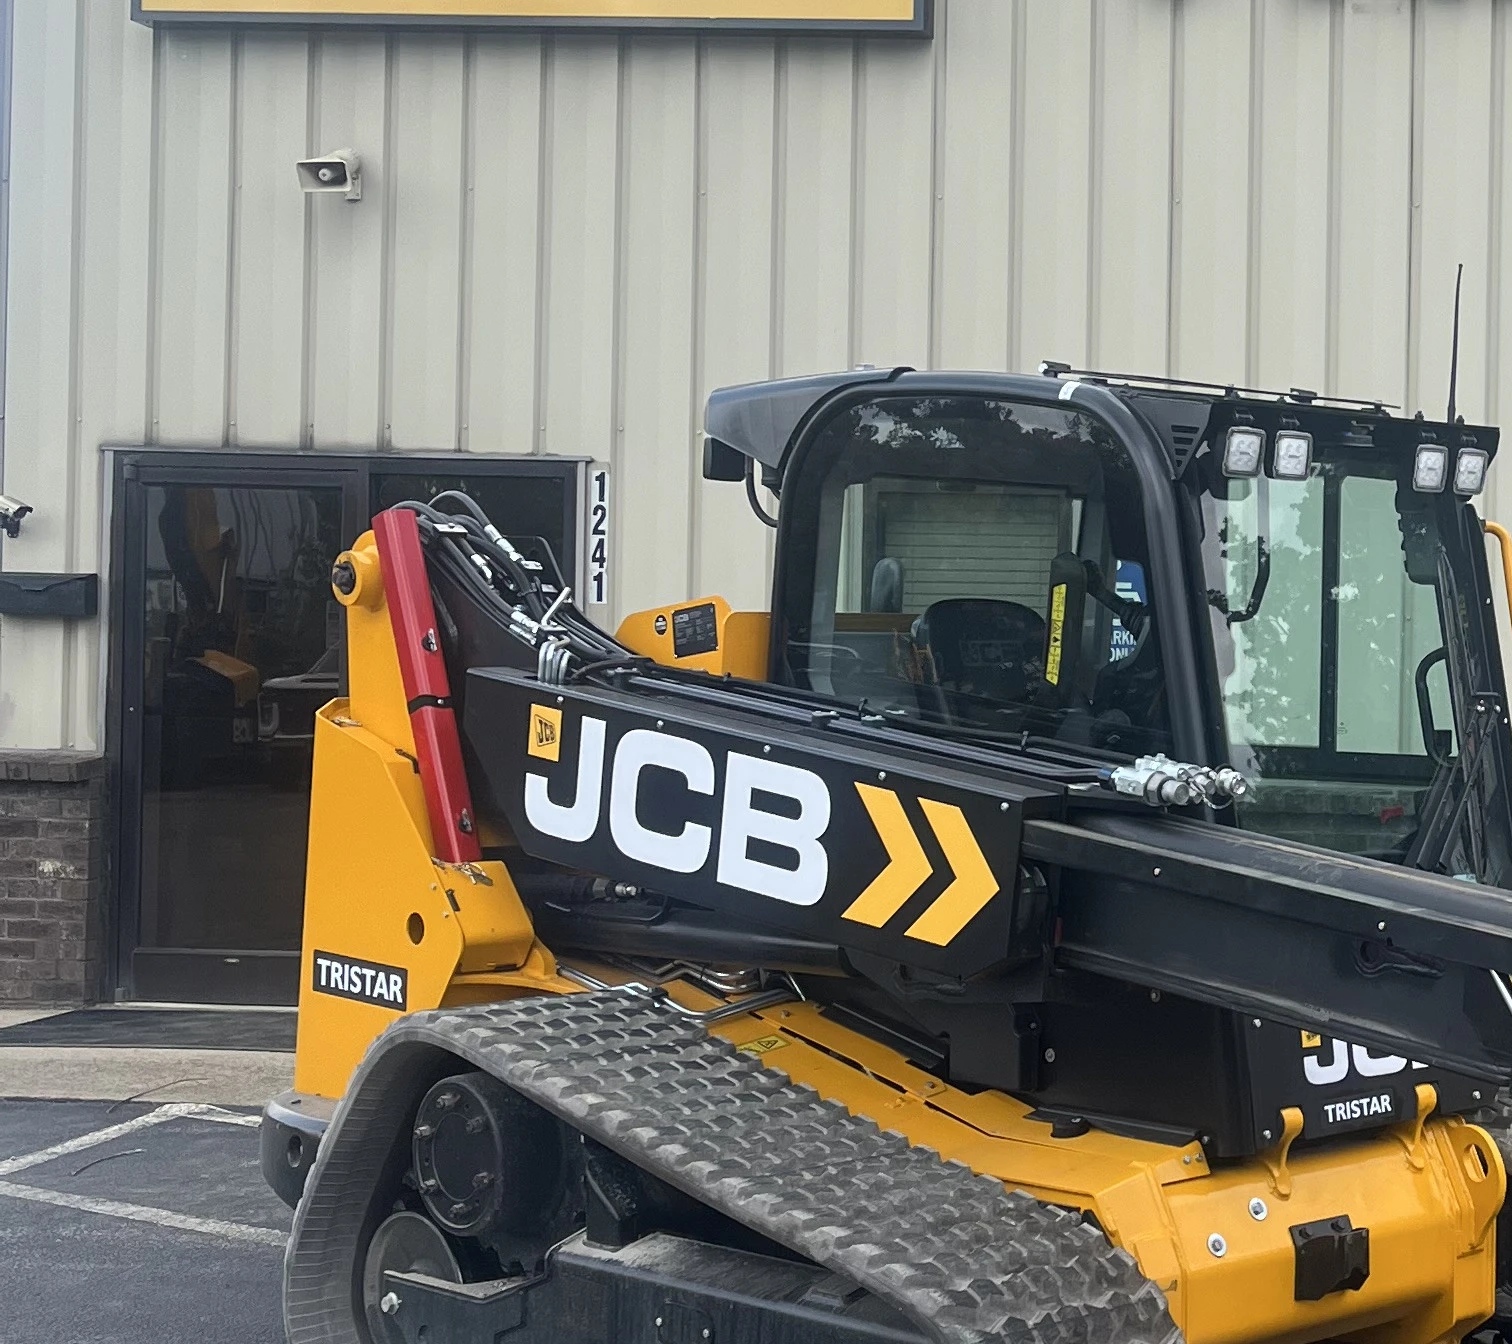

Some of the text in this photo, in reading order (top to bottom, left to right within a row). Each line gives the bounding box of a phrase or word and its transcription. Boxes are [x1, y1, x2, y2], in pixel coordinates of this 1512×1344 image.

[592, 471, 606, 602] 1241
[525, 715, 831, 906] JCB
[316, 957, 403, 1004] TRISTAR
[1303, 1037, 1430, 1085] JC
[1323, 1094, 1393, 1123] TRISTAR
